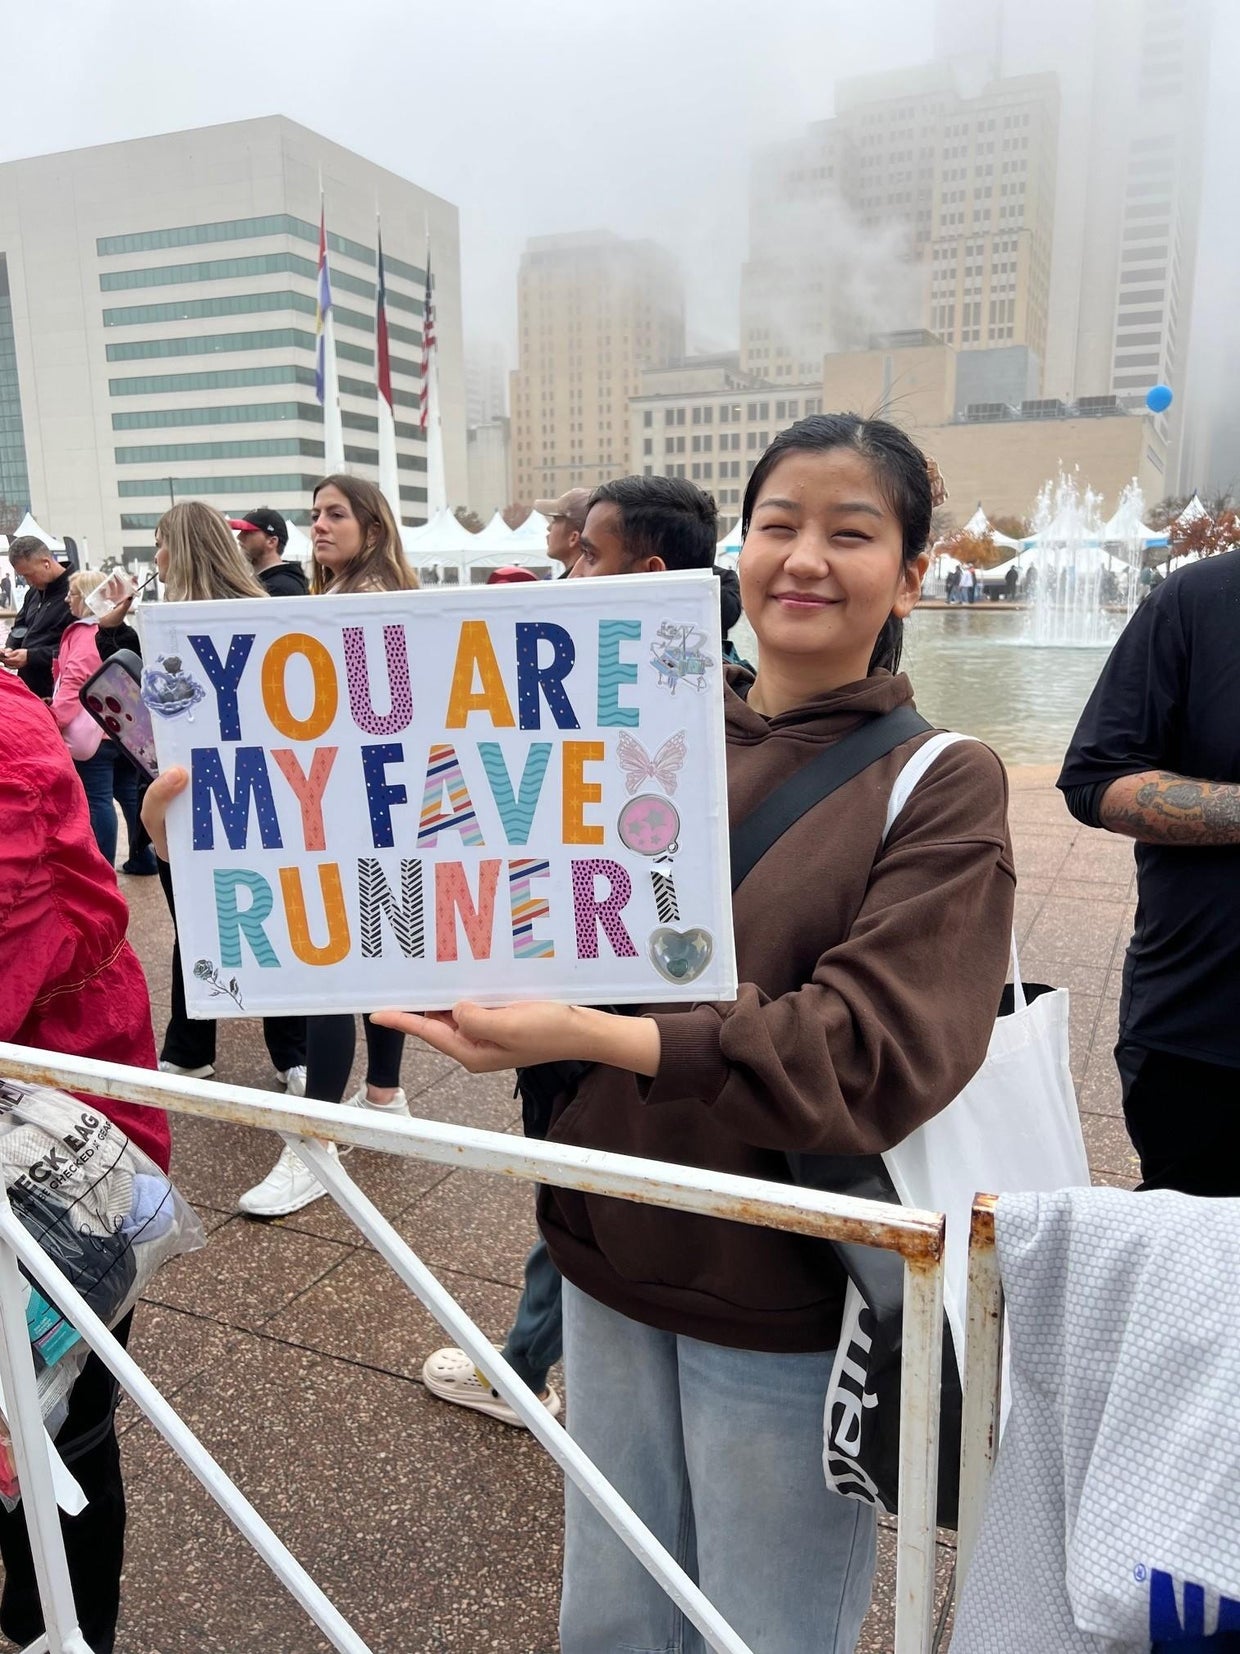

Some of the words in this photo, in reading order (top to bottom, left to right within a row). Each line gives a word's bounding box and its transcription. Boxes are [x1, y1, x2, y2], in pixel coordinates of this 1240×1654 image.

[187, 624, 413, 742] YOU
[445, 619, 642, 731] ARE
[191, 746, 340, 852] MY
[360, 741, 605, 849] FAVE
[49, 1148, 95, 1189] CHECKED
